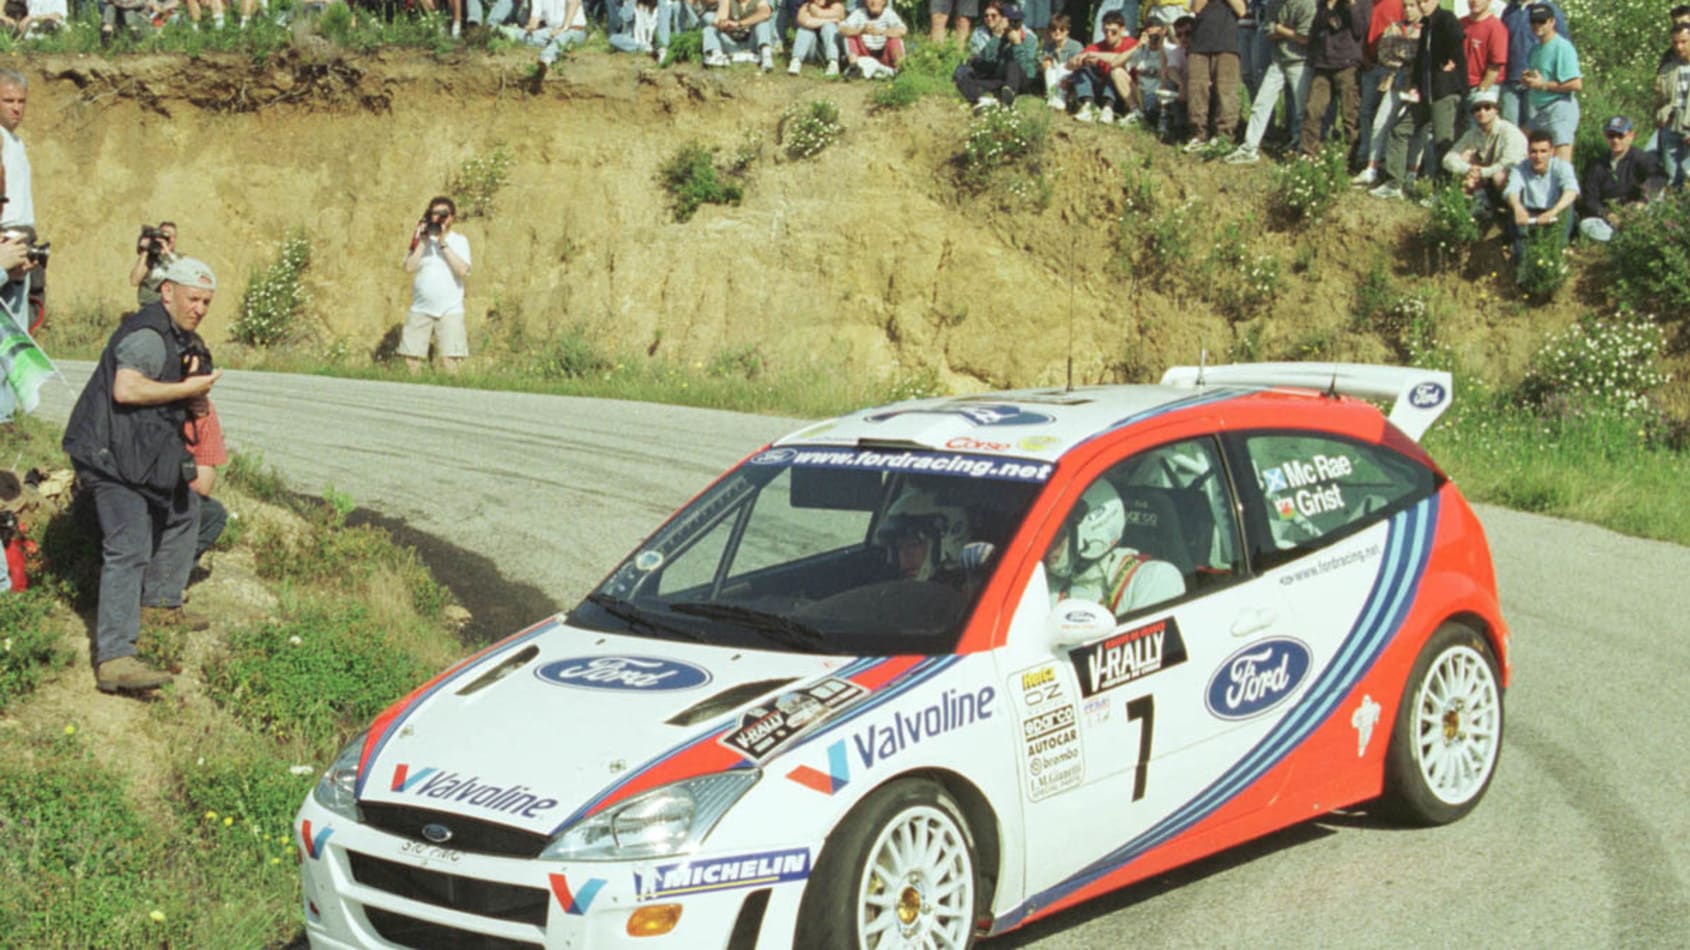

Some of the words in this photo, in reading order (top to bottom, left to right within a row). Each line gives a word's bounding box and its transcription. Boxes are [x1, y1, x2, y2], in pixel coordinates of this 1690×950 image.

[793, 449, 1052, 480] www.fordracing.net
[1284, 460, 1316, 488] Mc
[1314, 454, 1353, 481] Rae
[1297, 484, 1346, 518] Grist
[558, 656, 679, 688] Ford
[1087, 630, 1166, 693] V-RALLY
[1225, 647, 1291, 709] Ford
[853, 685, 996, 770] Valvoline
[1024, 706, 1076, 737] sparco
[1027, 729, 1077, 757] AUTOCAR
[1126, 694, 1155, 803] 7
[416, 770, 559, 818] Valvoline
[664, 852, 807, 890] MICHELIN
